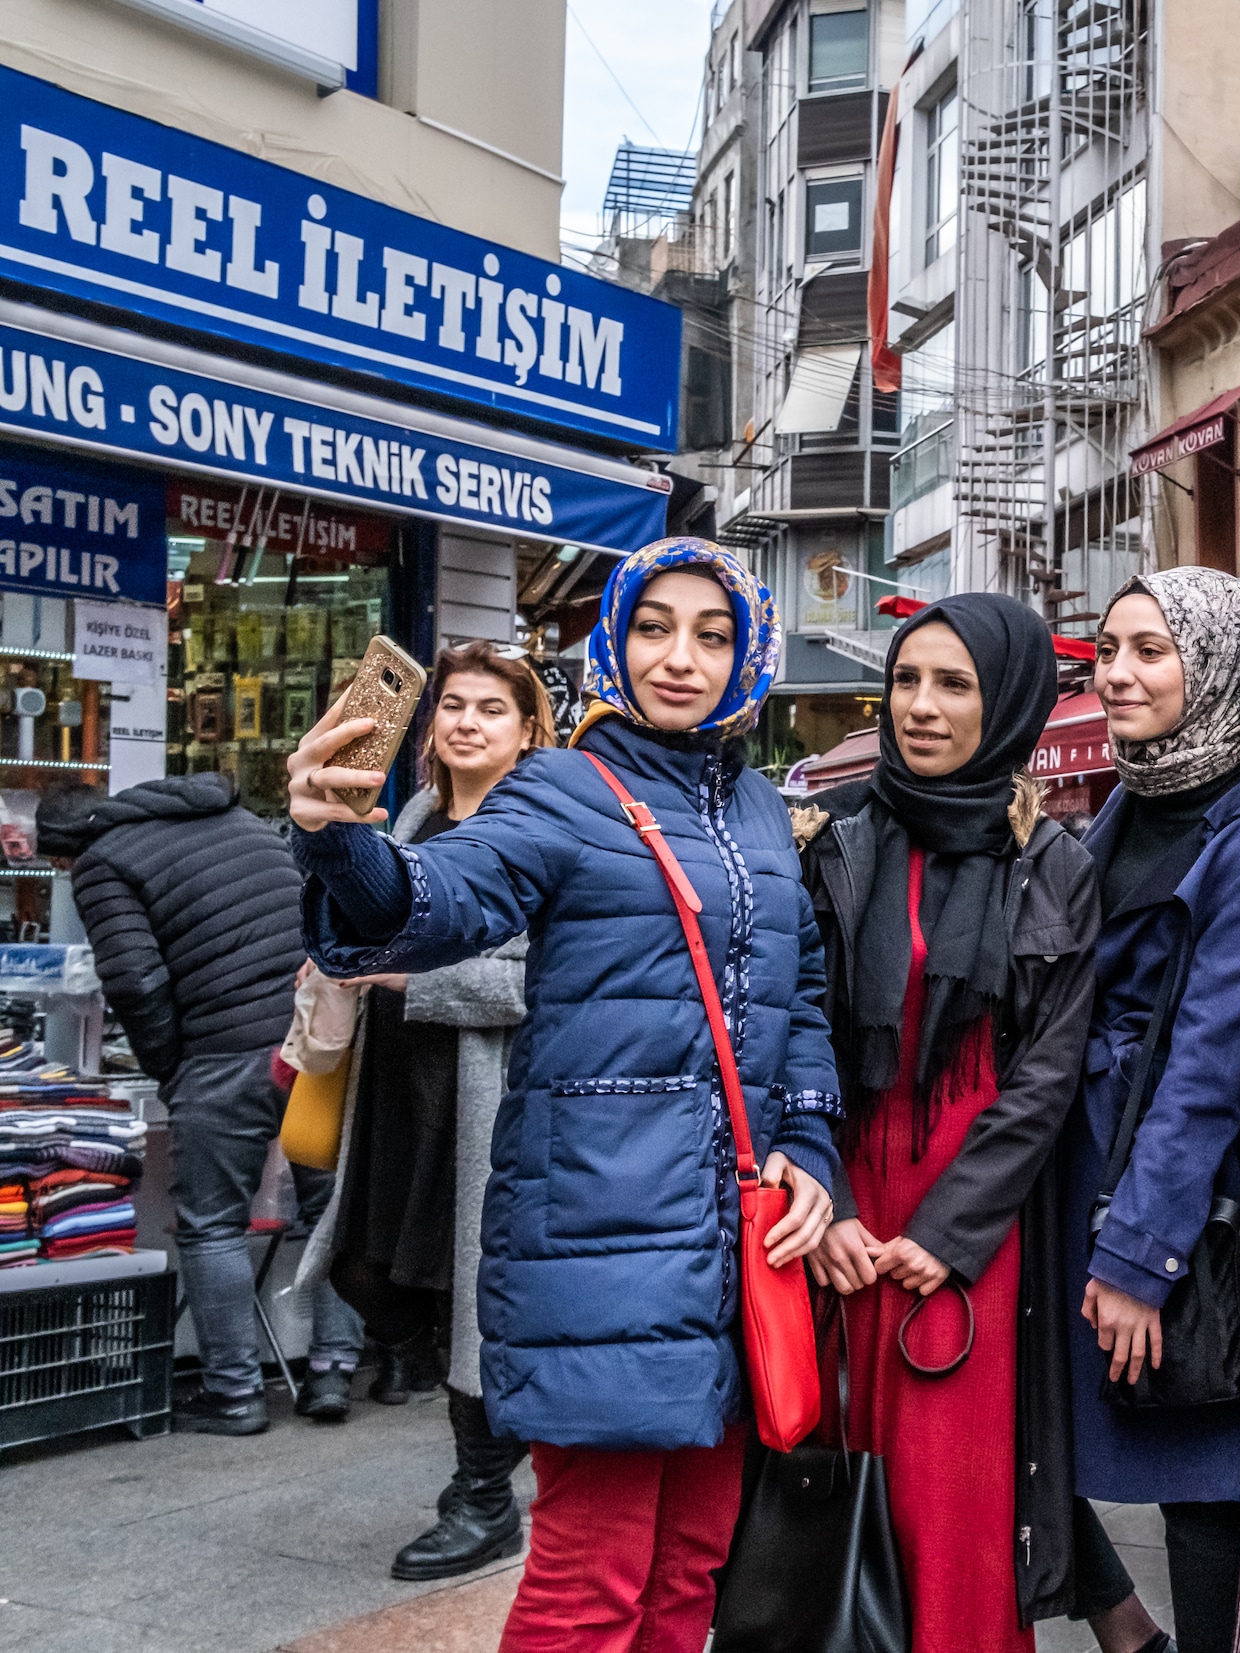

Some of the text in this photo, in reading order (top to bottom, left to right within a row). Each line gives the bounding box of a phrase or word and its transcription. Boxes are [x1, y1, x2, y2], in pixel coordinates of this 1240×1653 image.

[19, 124, 624, 397] REEL İLETİŞİM
[0, 346, 106, 430] UNG
[149, 385, 275, 465] SONY
[1178, 417, 1224, 455] KOVAN
[1132, 445, 1173, 474] KOVAN
[0, 479, 138, 539] SATIM
[181, 494, 246, 532] REEL
[84, 644, 118, 658] LAZER
[124, 624, 151, 641] ÖZEL
